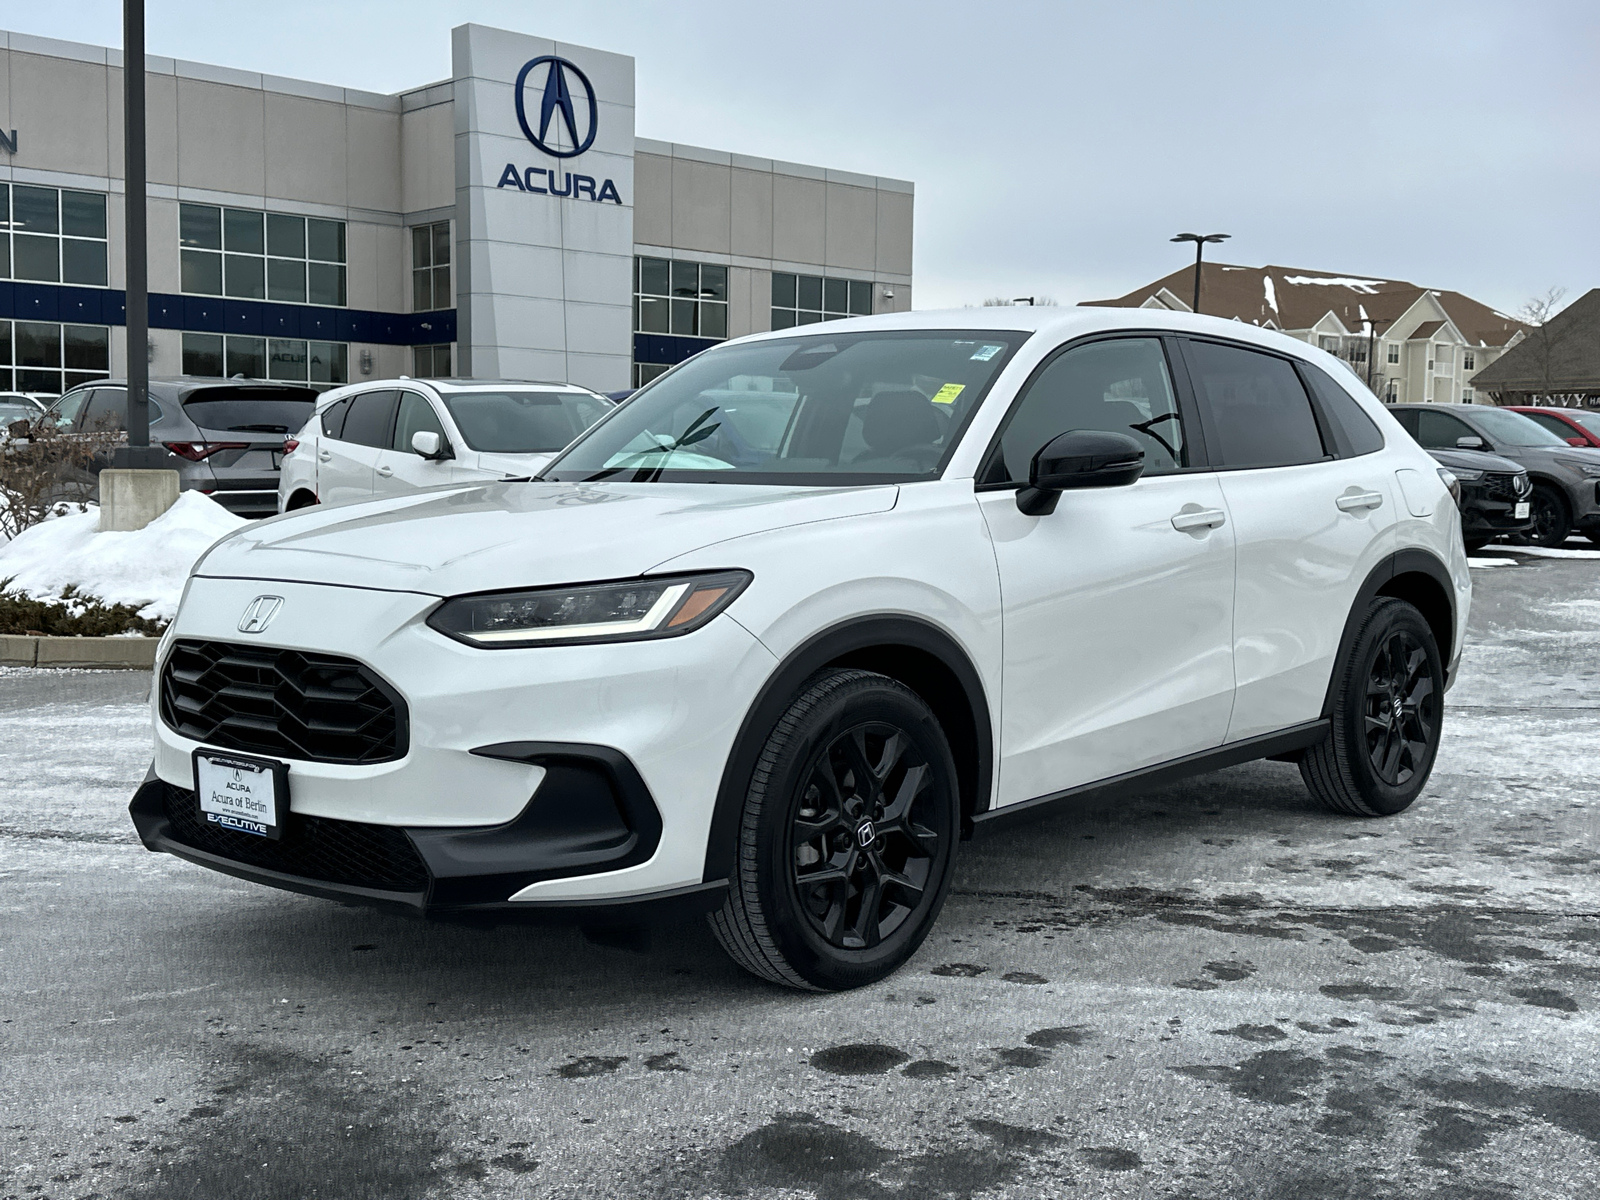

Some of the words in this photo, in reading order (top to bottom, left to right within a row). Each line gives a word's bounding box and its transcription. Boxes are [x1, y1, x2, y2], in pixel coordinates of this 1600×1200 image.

[497, 163, 622, 204] ACURA
[1532, 393, 1587, 407] ENVY
[226, 782, 251, 793] ACURA
[211, 791, 234, 806] Acura
[235, 797, 243, 808] of
[245, 797, 267, 814] Berlin
[207, 813, 267, 833] EXECUTIVE
